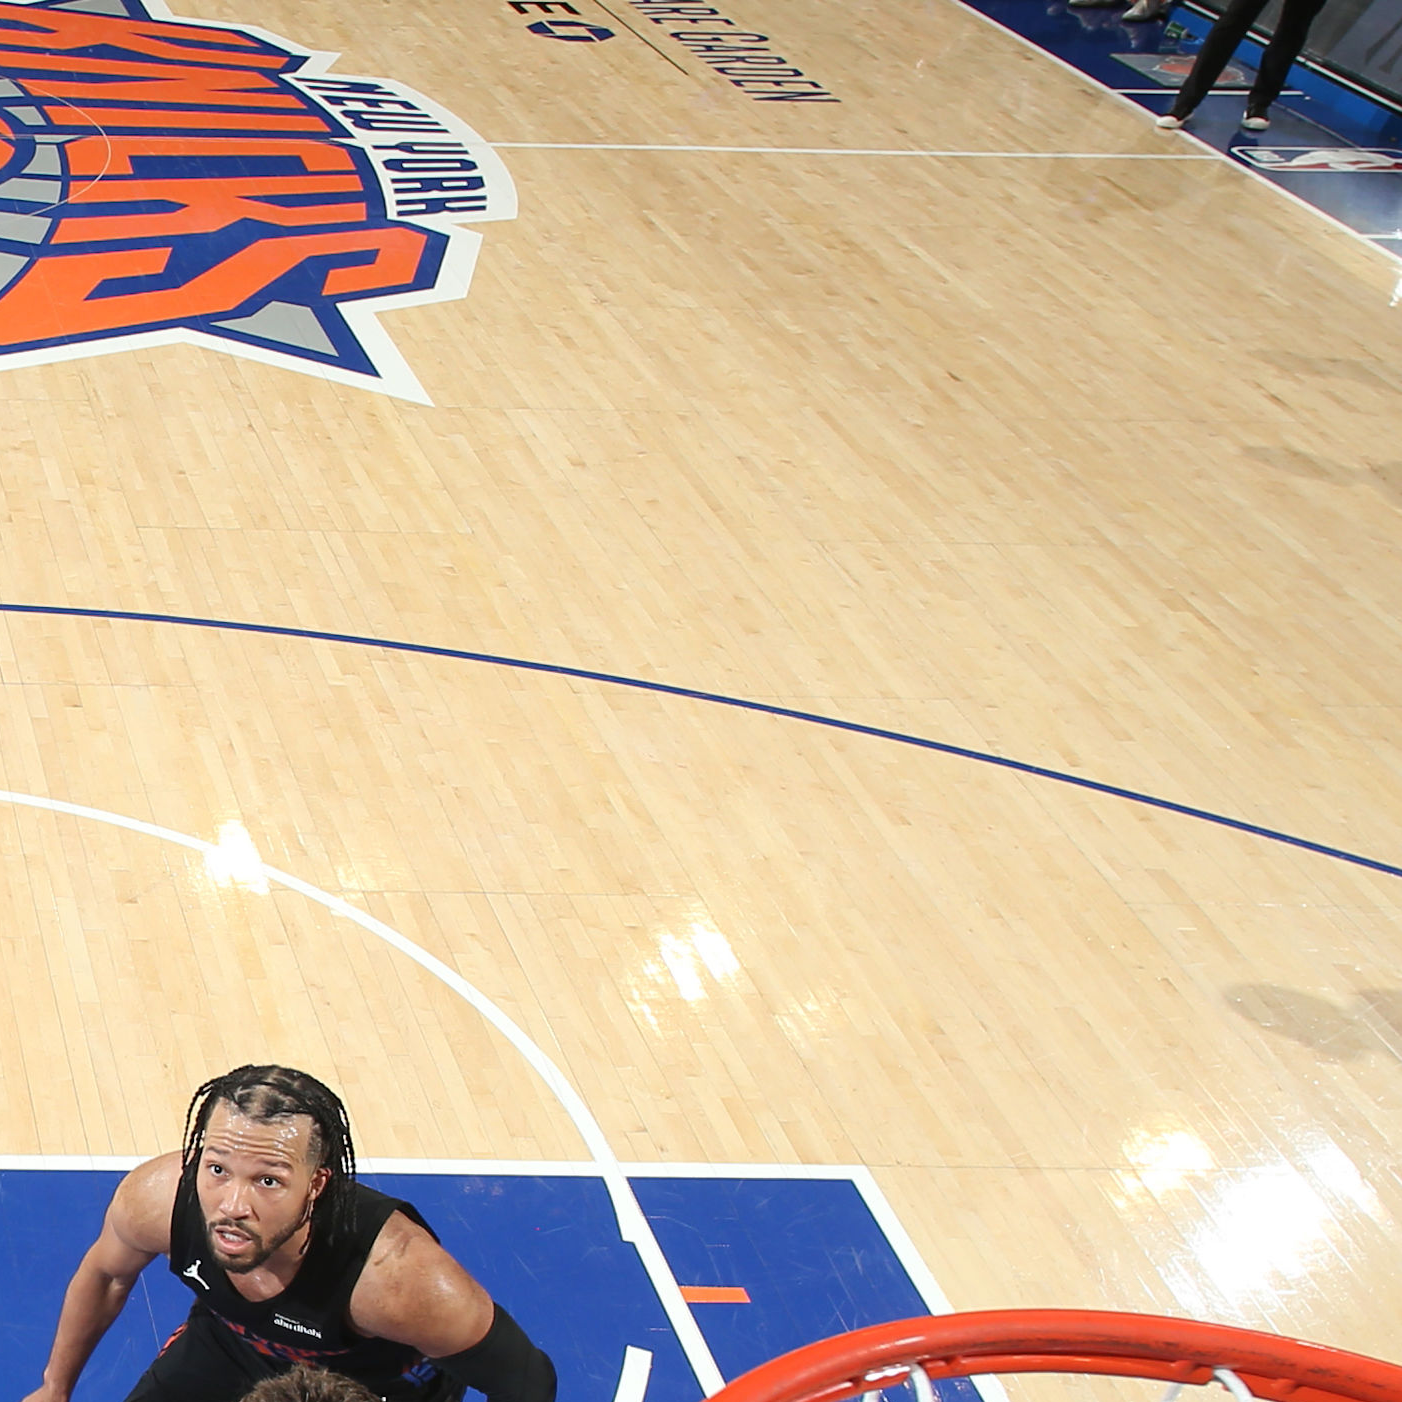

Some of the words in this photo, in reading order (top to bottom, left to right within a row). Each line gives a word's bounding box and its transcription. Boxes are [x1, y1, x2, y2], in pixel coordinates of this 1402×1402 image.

[669, 31, 842, 103] GARDEN
[292, 77, 451, 133] NEW
[371, 142, 488, 216] YORK
